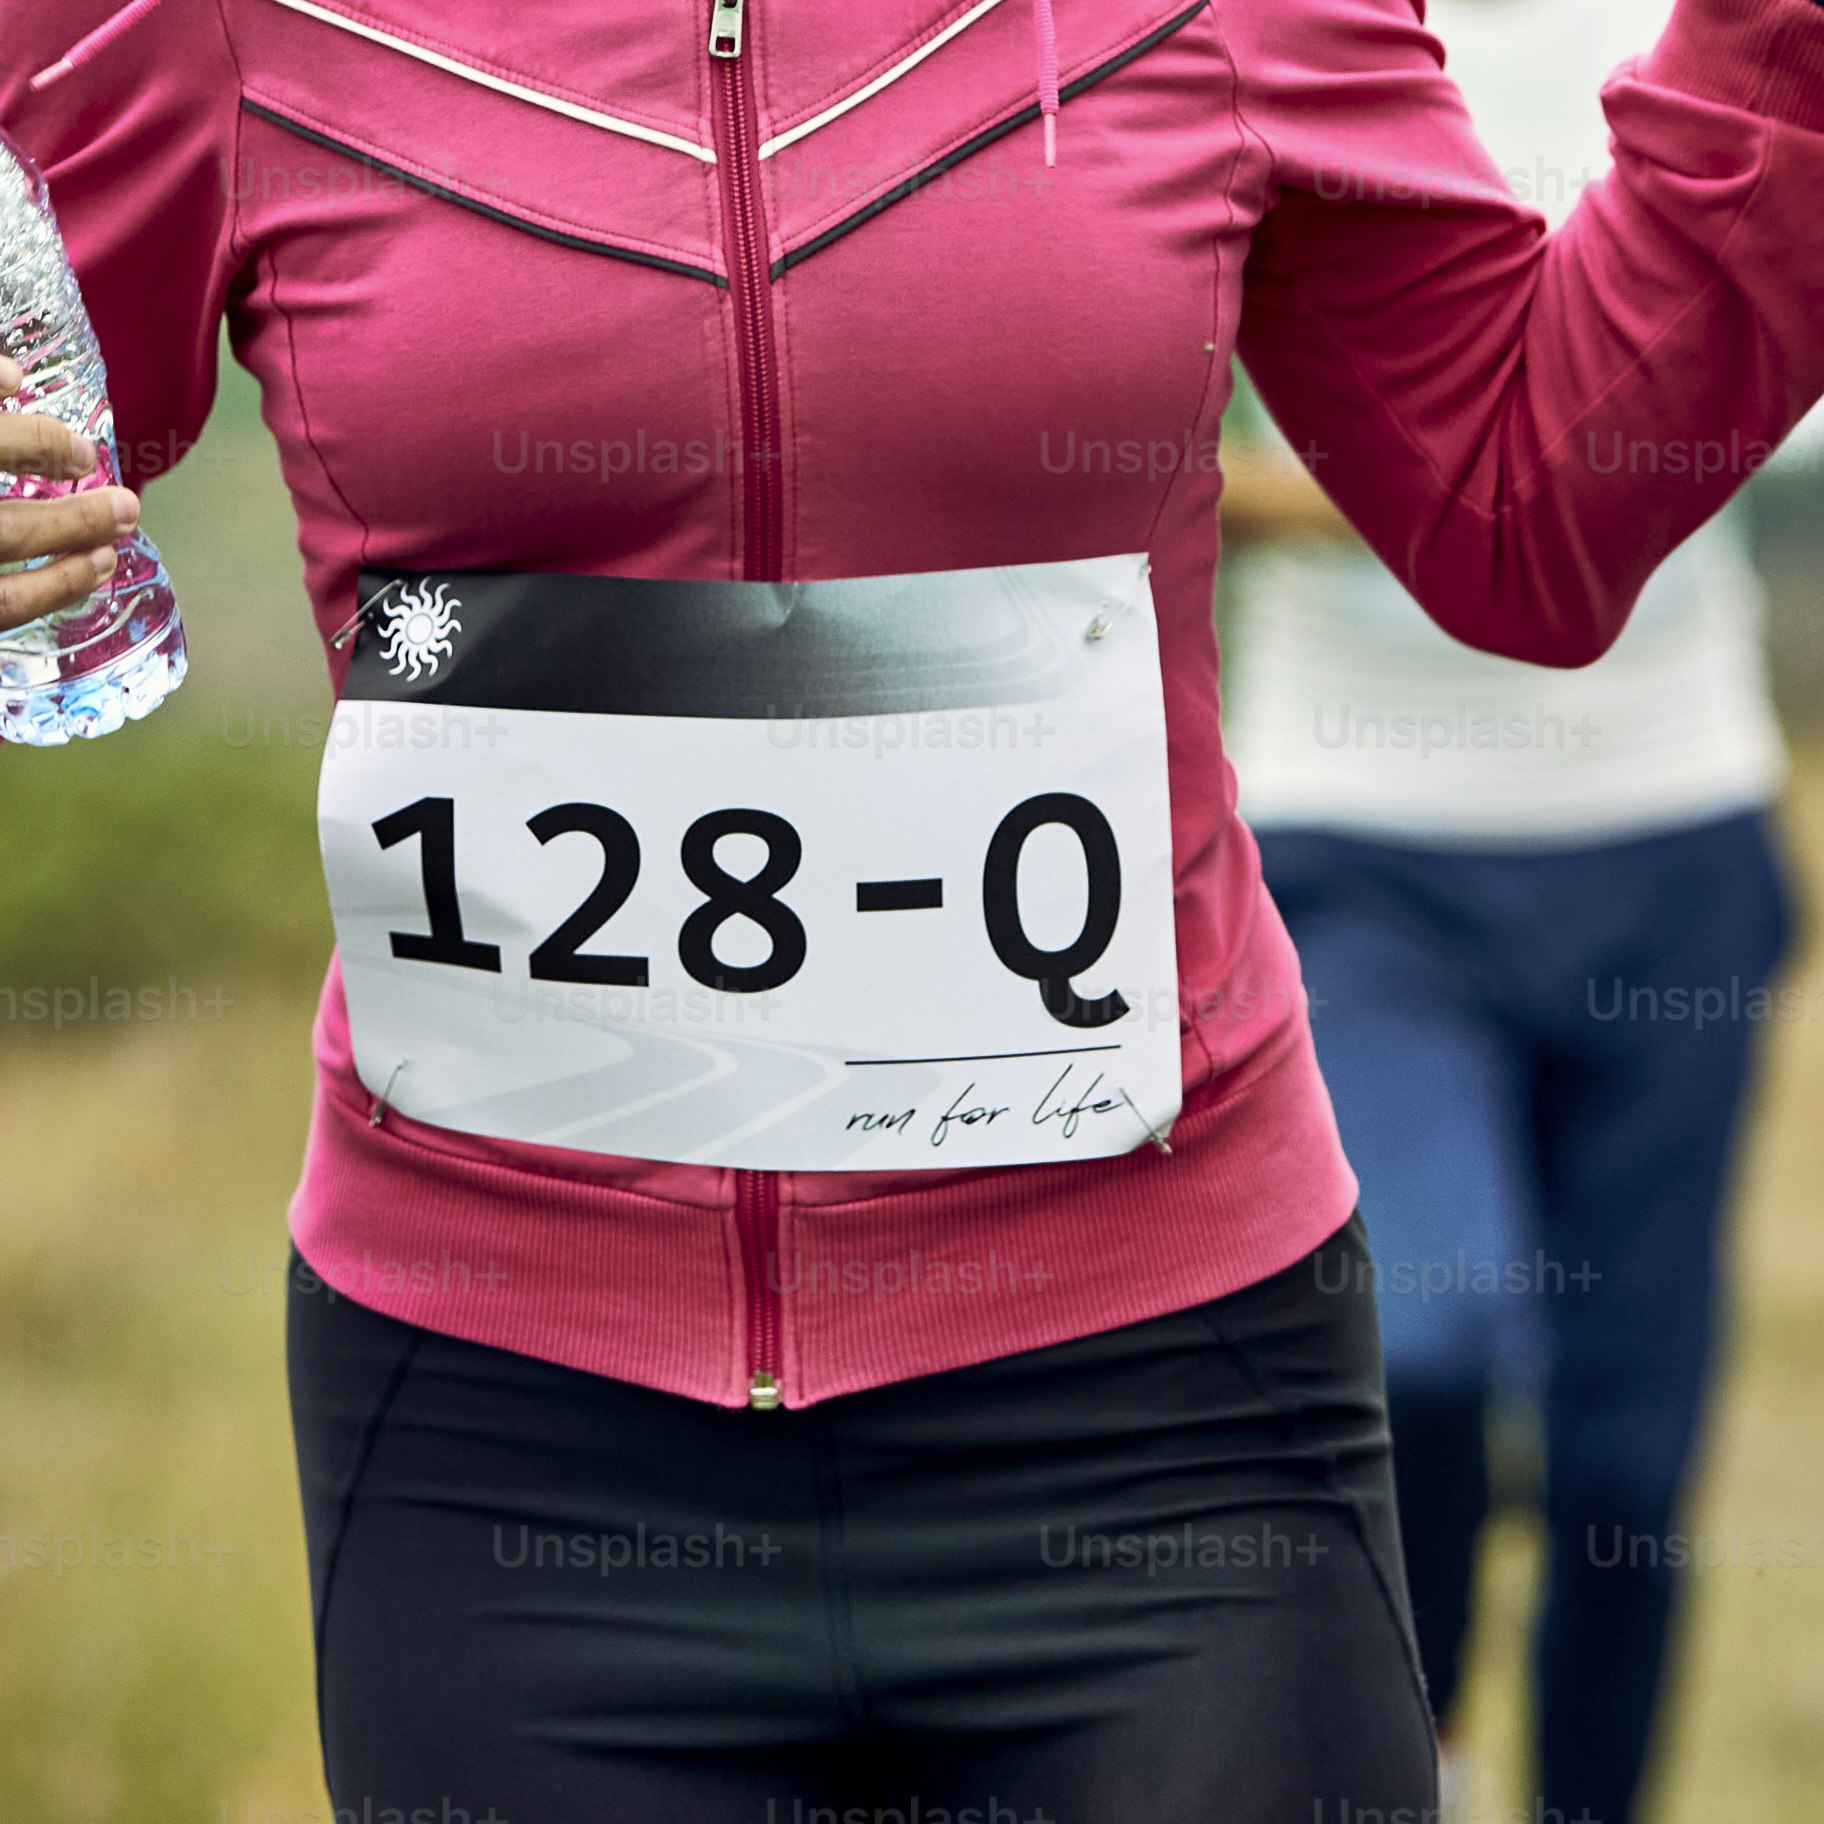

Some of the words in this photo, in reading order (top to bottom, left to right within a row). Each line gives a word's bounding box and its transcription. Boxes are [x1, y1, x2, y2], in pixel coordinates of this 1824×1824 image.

[371, 792, 1130, 1029] 128-Q
[845, 1108, 915, 1136] run
[931, 1082, 1010, 1147] for
[1032, 1062, 1124, 1139] life
